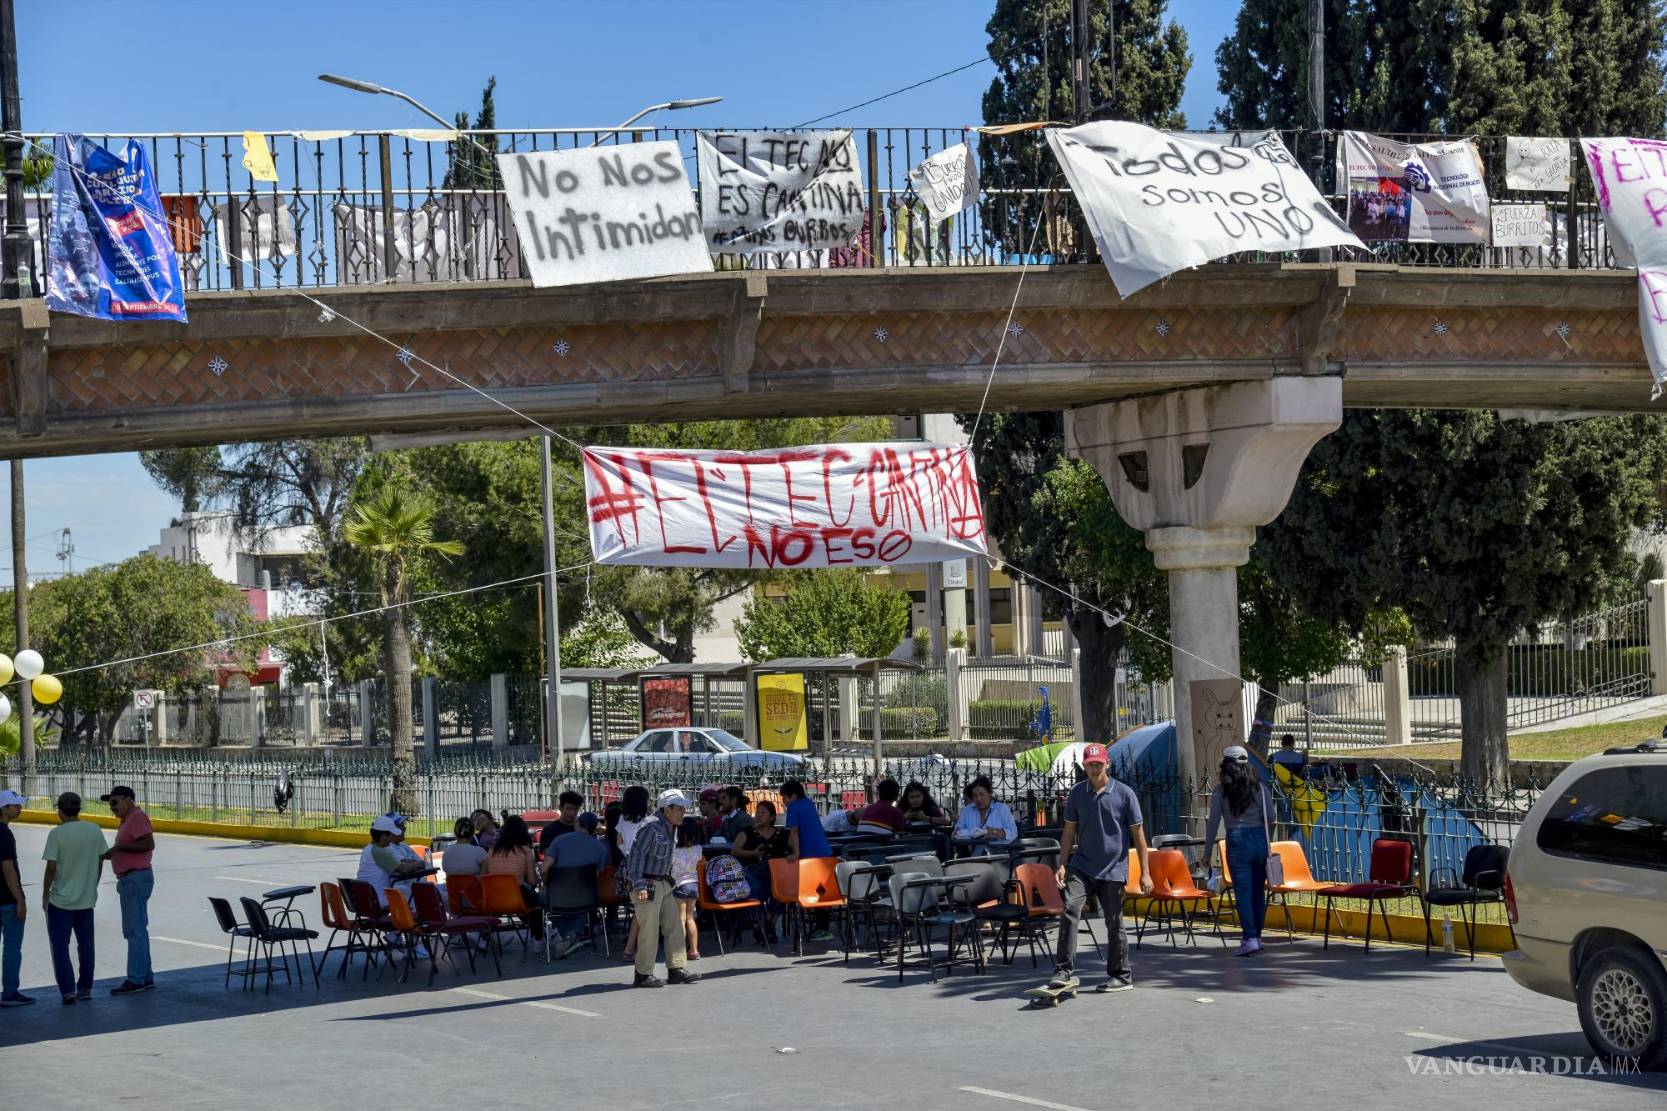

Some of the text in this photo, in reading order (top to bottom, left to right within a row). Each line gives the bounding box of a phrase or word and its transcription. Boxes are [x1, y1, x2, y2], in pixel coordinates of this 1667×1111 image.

[761, 139, 811, 172] TEC
[718, 184, 750, 216] ES
[526, 202, 703, 261] Intimidan
[1214, 206, 1314, 240] UNO
